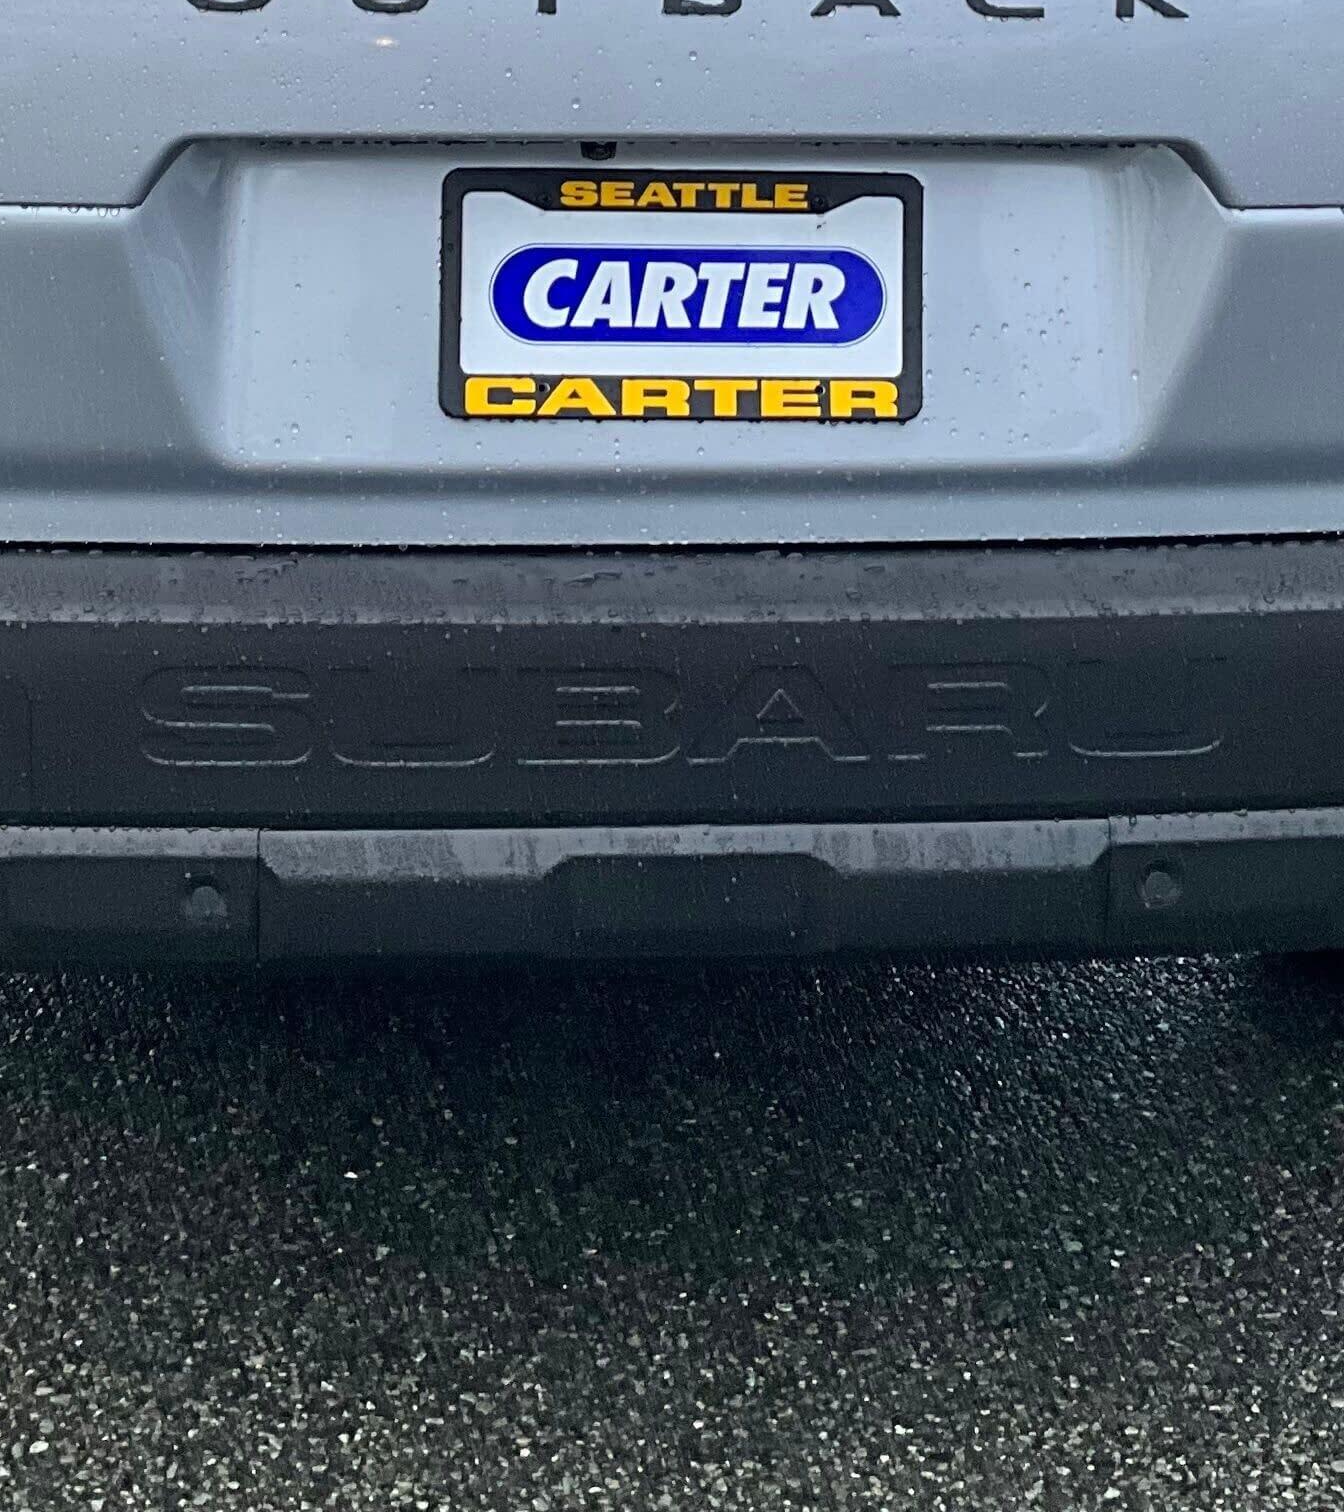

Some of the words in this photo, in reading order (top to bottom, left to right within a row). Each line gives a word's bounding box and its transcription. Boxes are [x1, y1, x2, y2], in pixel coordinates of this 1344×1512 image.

[560, 181, 809, 210] SEATTLE
[522, 258, 846, 330] CARTER
[464, 376, 899, 417] CARTER
[141, 658, 1227, 767] SUBARU
